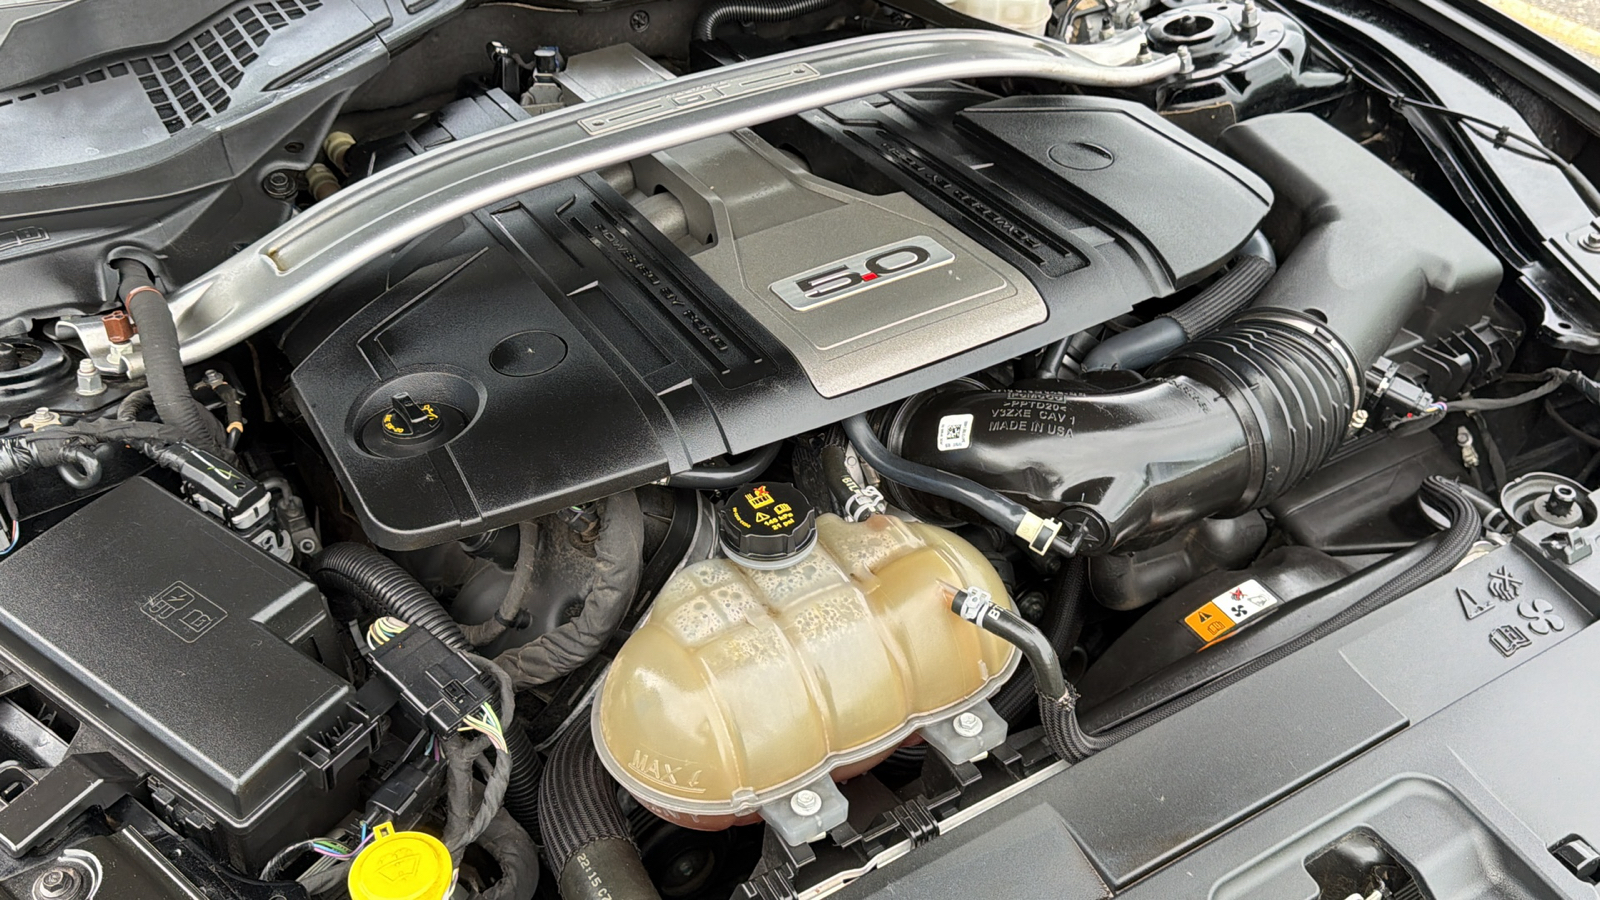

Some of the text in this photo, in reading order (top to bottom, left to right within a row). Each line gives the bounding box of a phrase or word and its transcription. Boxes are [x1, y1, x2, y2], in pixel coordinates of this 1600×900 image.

[795, 244, 931, 298] 5.0
[659, 287, 685, 307] BY
[1039, 411, 1067, 423] CAV
[988, 420, 1074, 439] MADE IN USA
[771, 523, 783, 531] 21
[631, 749, 682, 785] MAX
[576, 852, 603, 887] 22:15
